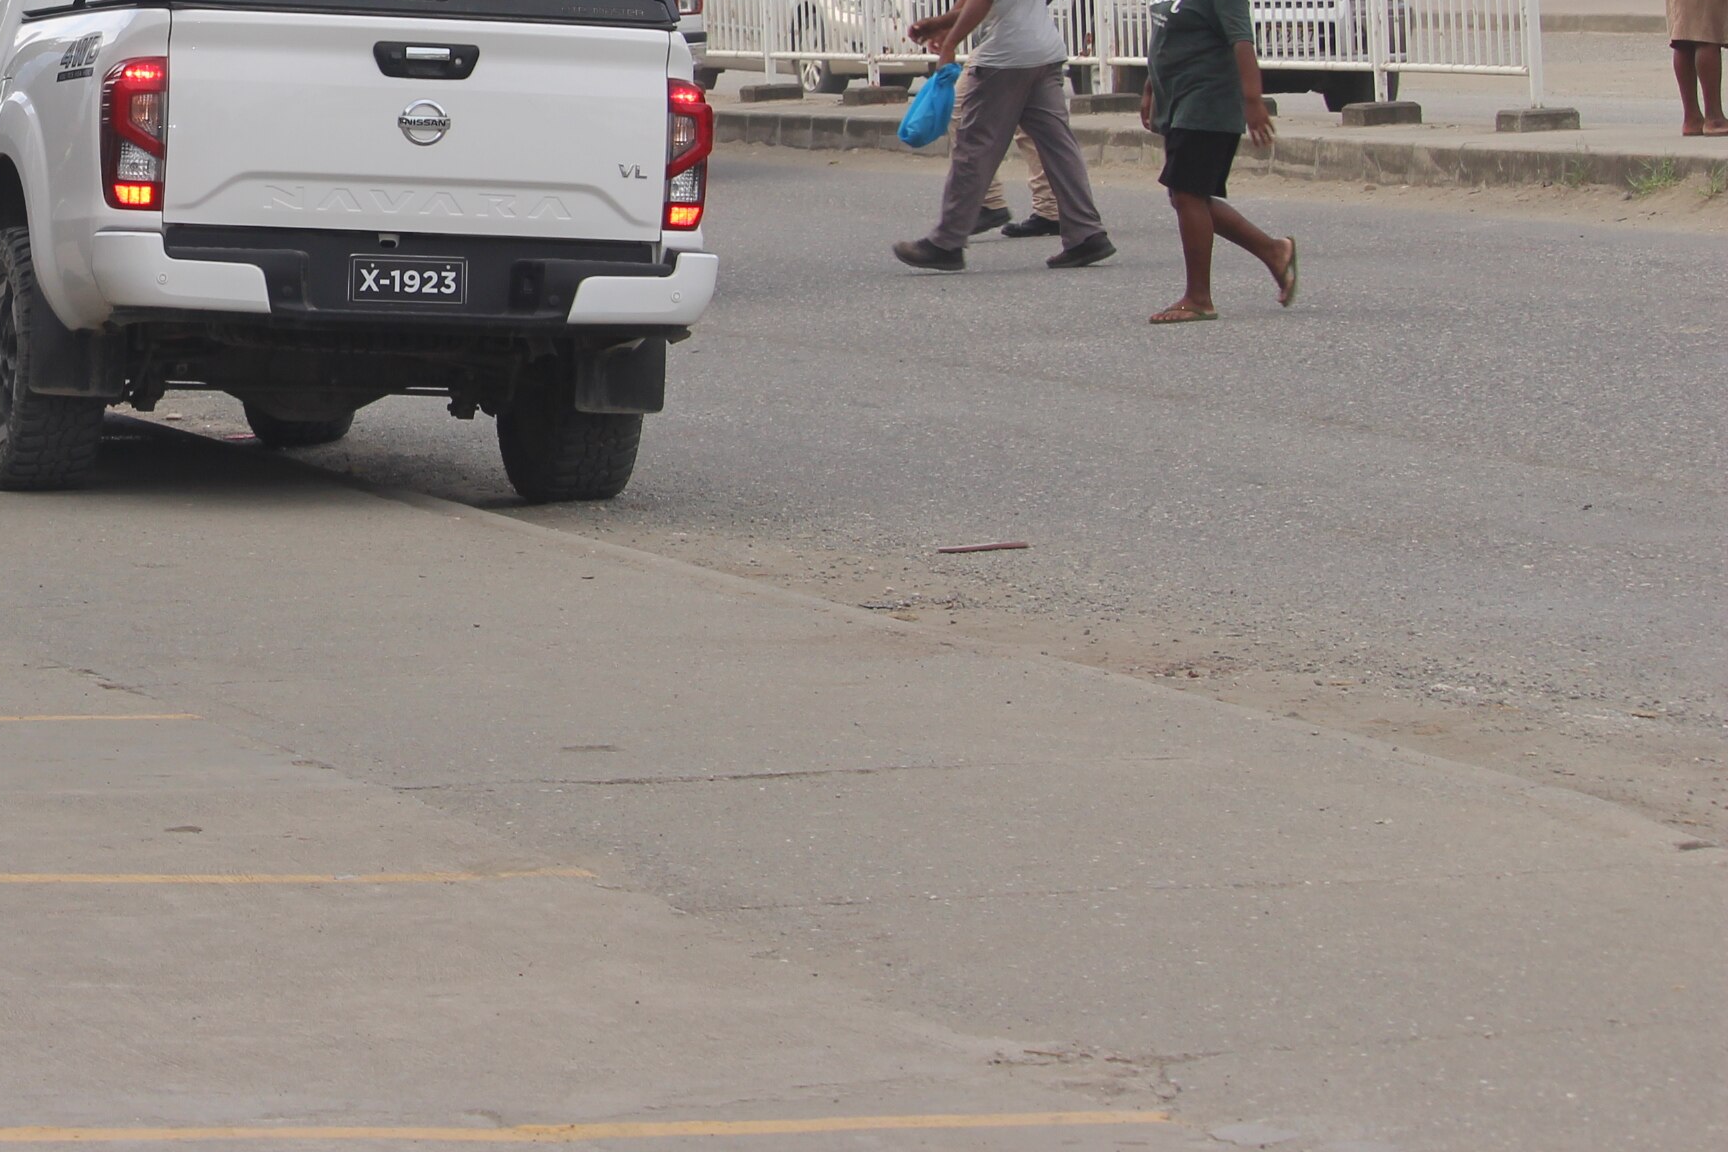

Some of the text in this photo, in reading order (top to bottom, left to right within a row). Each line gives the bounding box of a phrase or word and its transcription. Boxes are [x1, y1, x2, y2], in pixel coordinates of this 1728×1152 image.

[60, 32, 102, 69] 4WD
[403, 118, 446, 127] NISSAN
[618, 163, 648, 180] VL
[263, 184, 573, 221] NAVARA
[359, 268, 457, 295] X-1923
